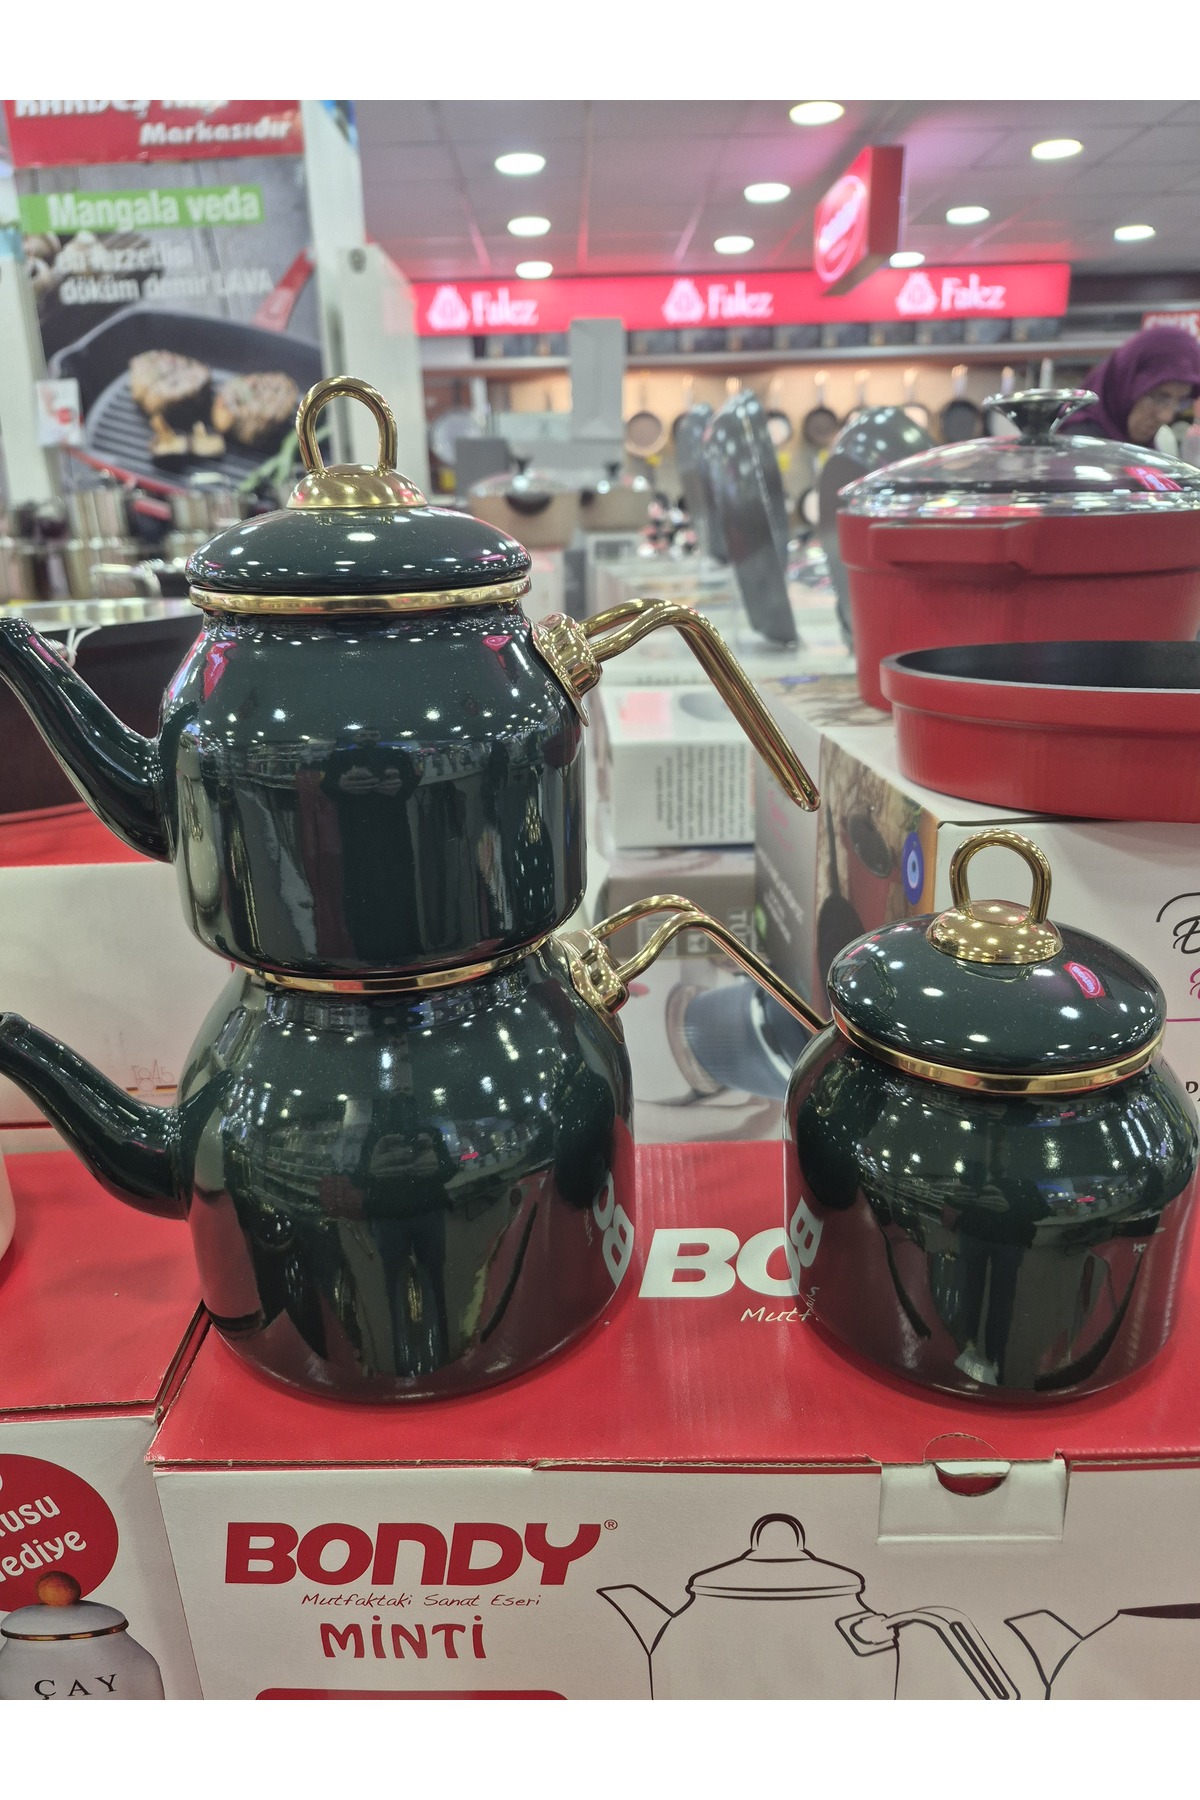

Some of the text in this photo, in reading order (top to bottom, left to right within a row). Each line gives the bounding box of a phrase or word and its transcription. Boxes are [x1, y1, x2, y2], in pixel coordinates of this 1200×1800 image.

[48, 186, 261, 233] Mangala veda
[472, 287, 539, 327] Falez
[707, 280, 775, 319] Falez
[941, 272, 1007, 312] Falez
[0, 1495, 60, 1537] usu
[0, 1531, 87, 1582] ediye
[225, 1522, 602, 1586] BONDY
[301, 1592, 541, 1608] Mutfaktaki Sanat Eseri
[34, 1673, 117, 1700] ÇAY
